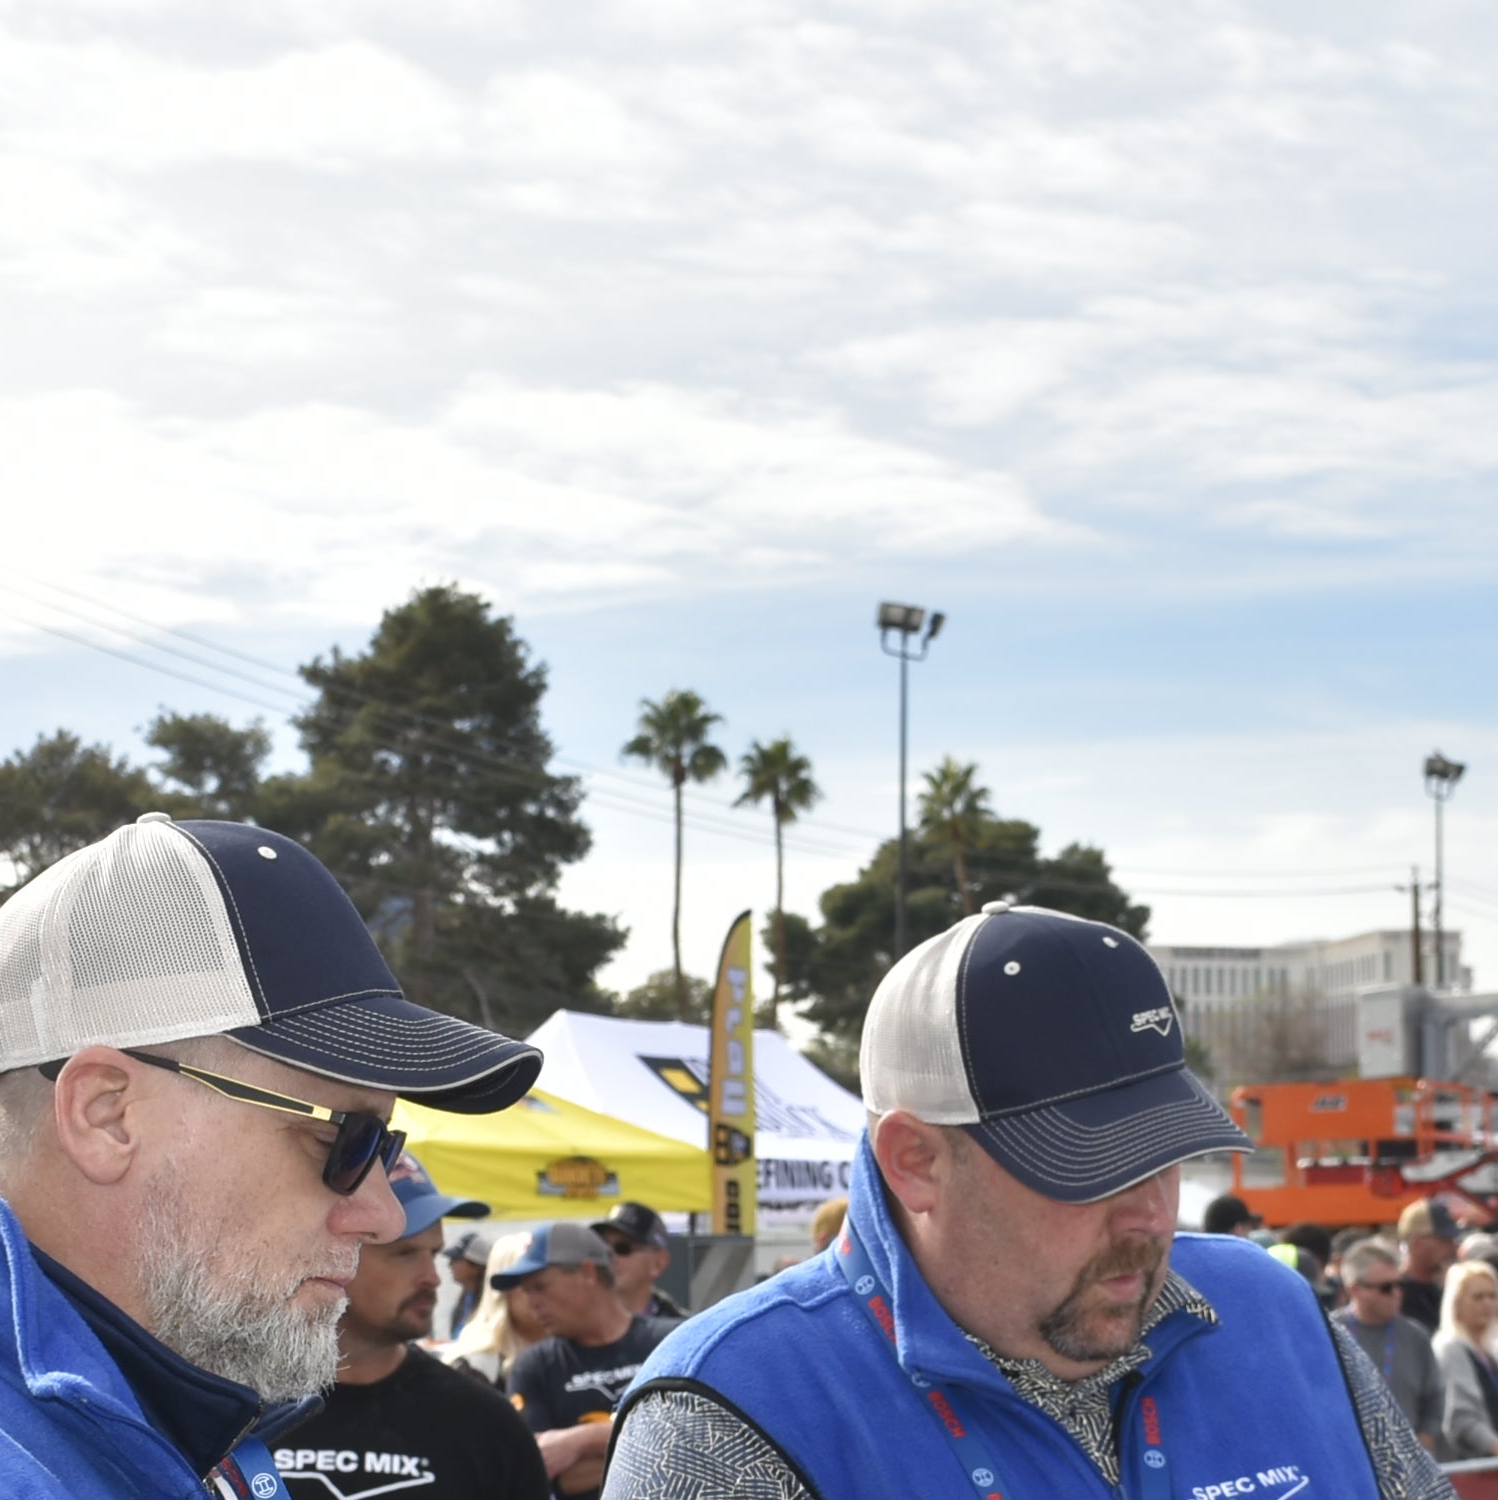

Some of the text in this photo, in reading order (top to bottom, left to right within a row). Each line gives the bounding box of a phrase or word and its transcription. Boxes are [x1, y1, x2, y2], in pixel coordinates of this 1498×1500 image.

[868, 1296, 898, 1345] BOSC
[927, 1390, 967, 1439] BOSCH
[273, 1448, 421, 1477] SPEC MIX
[1256, 1465, 1299, 1488] MIX
